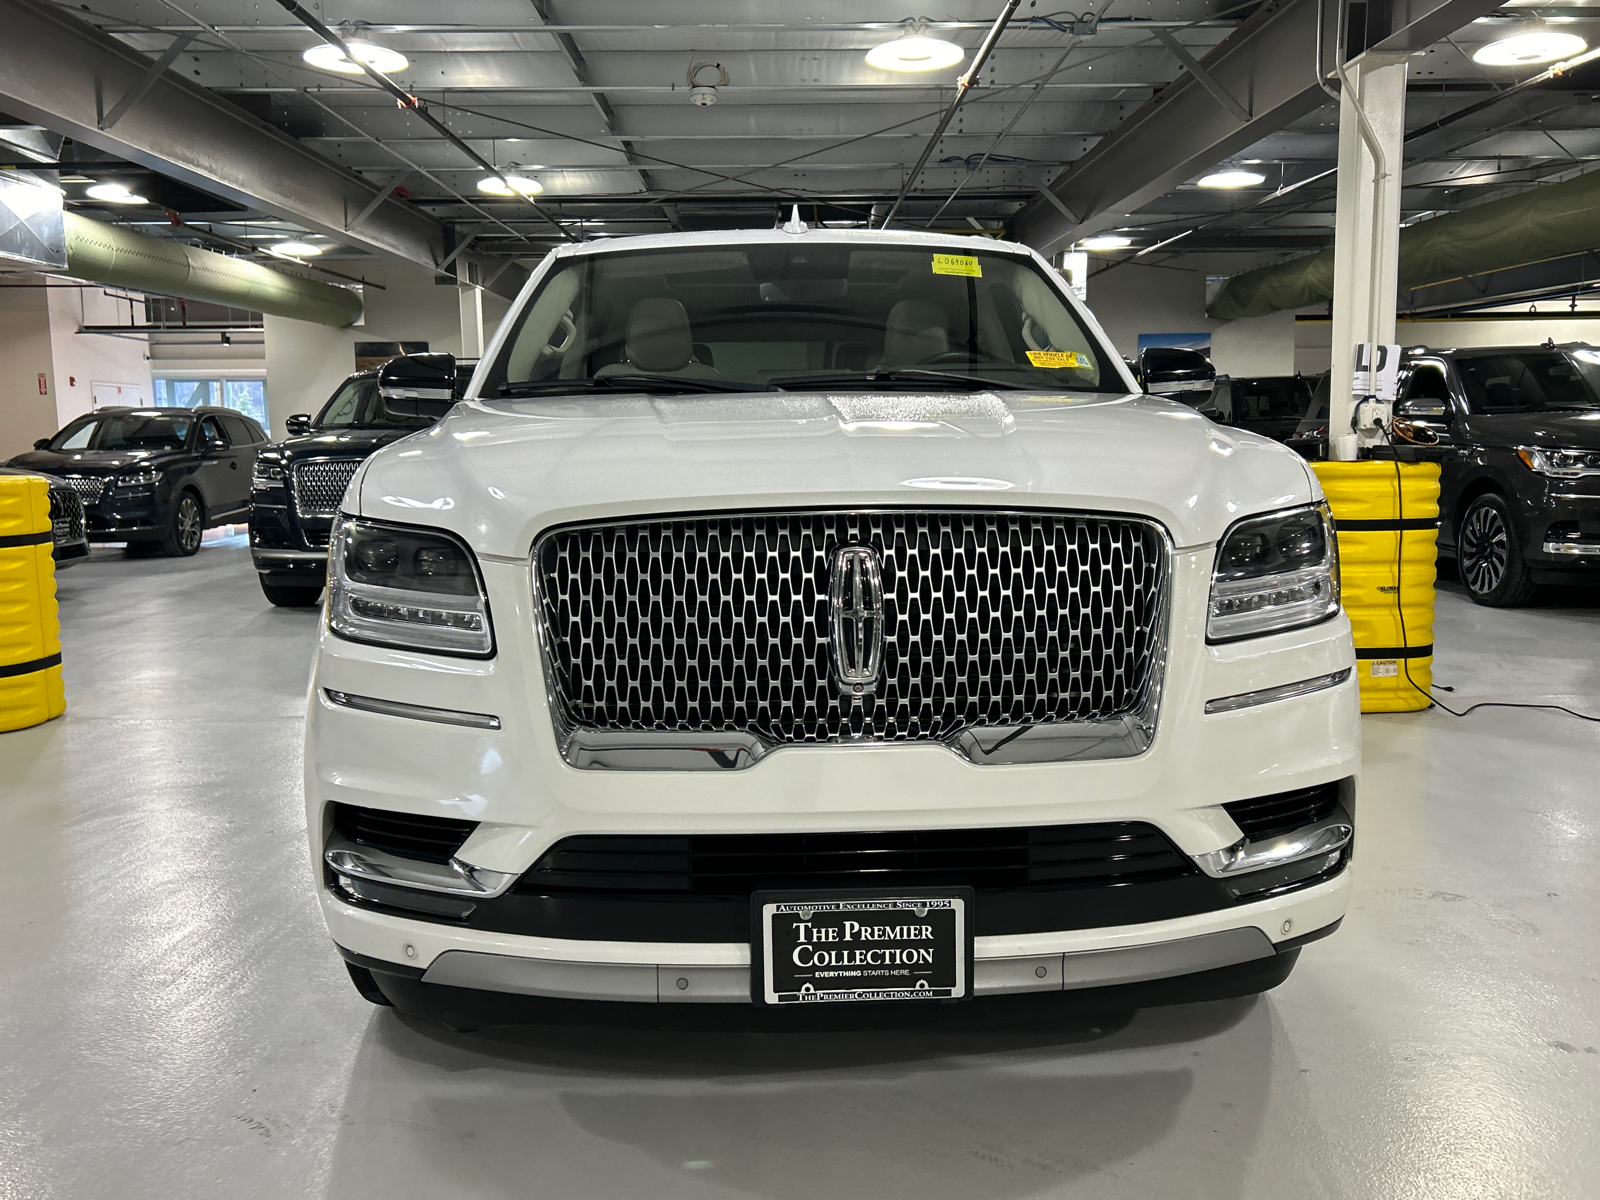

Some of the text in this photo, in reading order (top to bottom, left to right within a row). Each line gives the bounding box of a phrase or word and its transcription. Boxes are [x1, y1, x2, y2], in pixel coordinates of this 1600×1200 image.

[778, 904, 837, 912] AUTOMOTIVE
[840, 902, 893, 910] EXCELLENCE
[926, 900, 950, 908] 1995
[792, 920, 934, 943] THE PREMIER
[792, 945, 934, 967] COLLECTION
[815, 970, 861, 978] EVERYTHING
[797, 990, 933, 1001] THEPREMIERCOLLECTION.COM
